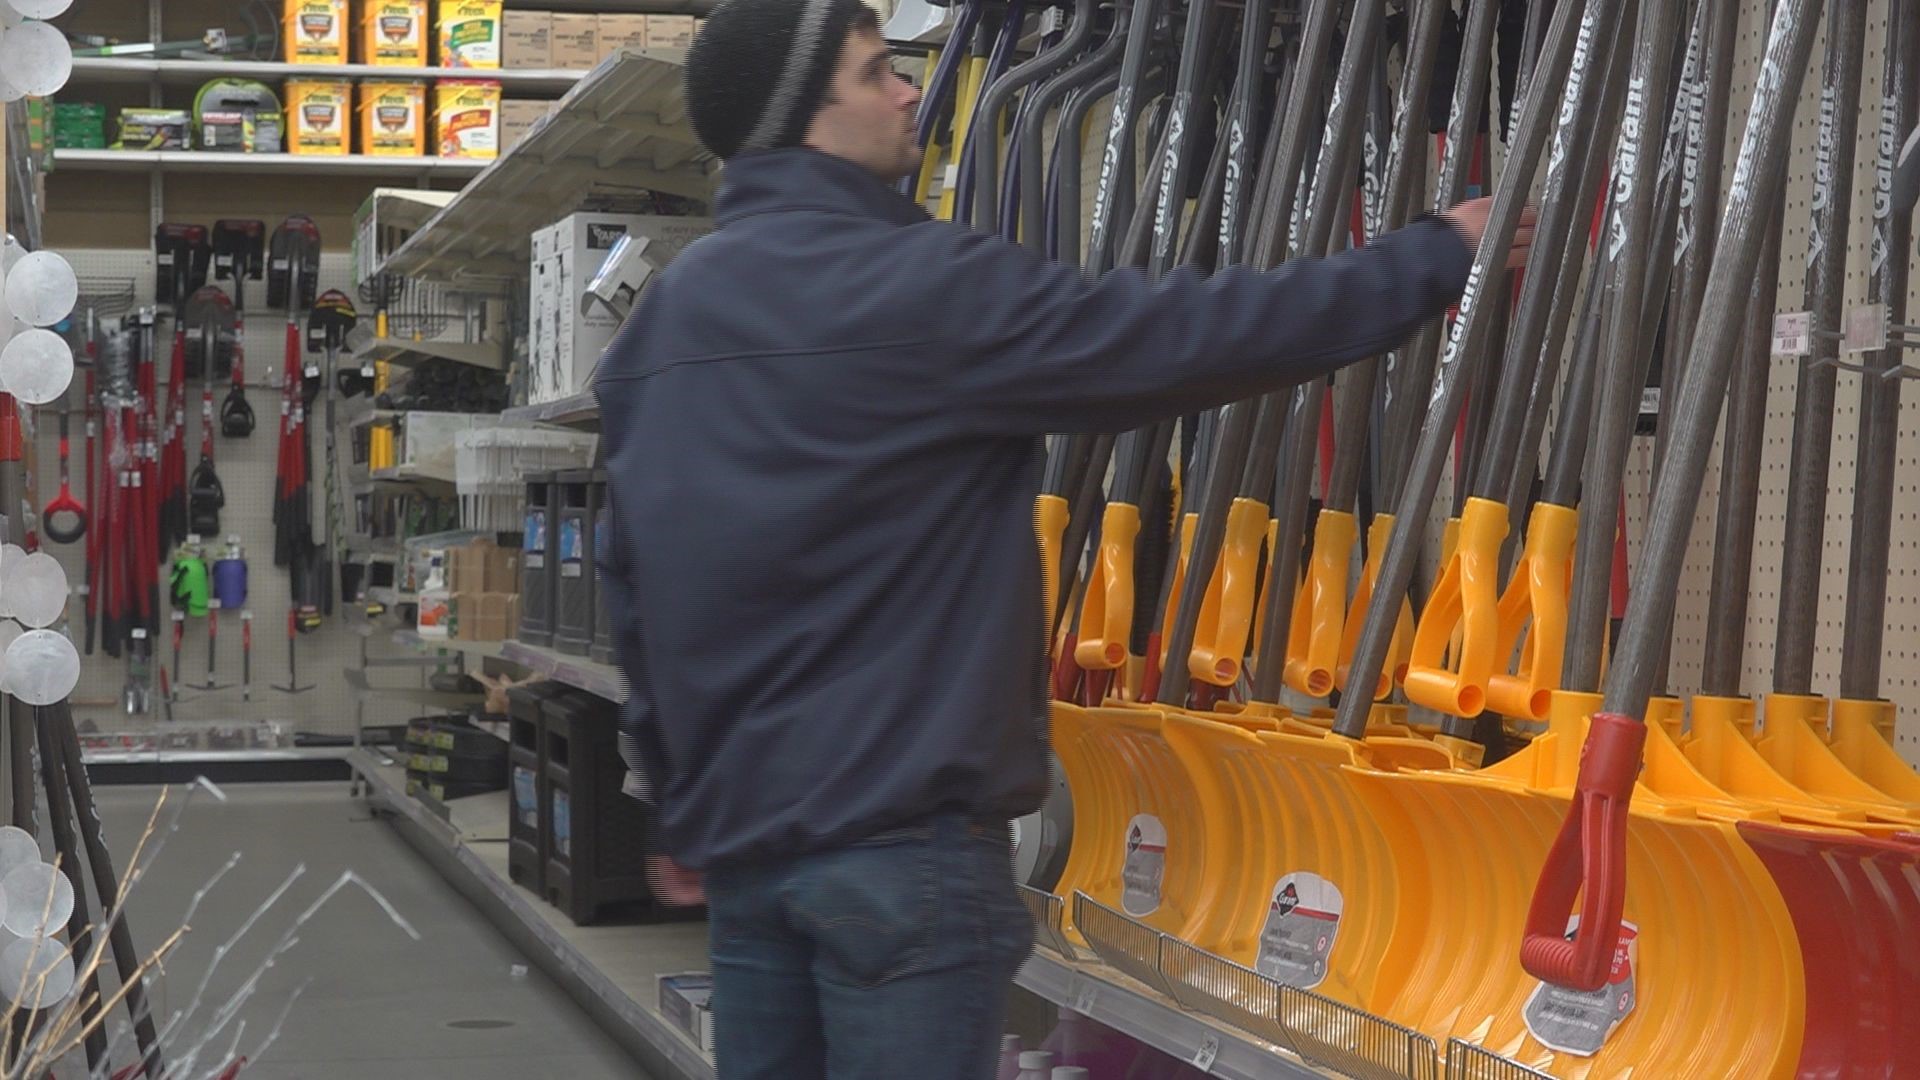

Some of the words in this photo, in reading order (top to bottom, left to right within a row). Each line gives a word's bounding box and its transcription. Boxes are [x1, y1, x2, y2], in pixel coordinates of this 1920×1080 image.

[1559, 15, 1593, 125] Garant
[1154, 149, 1179, 236] Garant
[1615, 77, 1644, 203] Garant
[1680, 82, 1704, 208] Garant
[1812, 86, 1834, 211] Garant
[1873, 95, 1896, 219] Garant
[1219, 159, 1241, 246] Garant
[1442, 275, 1482, 363] Garant
